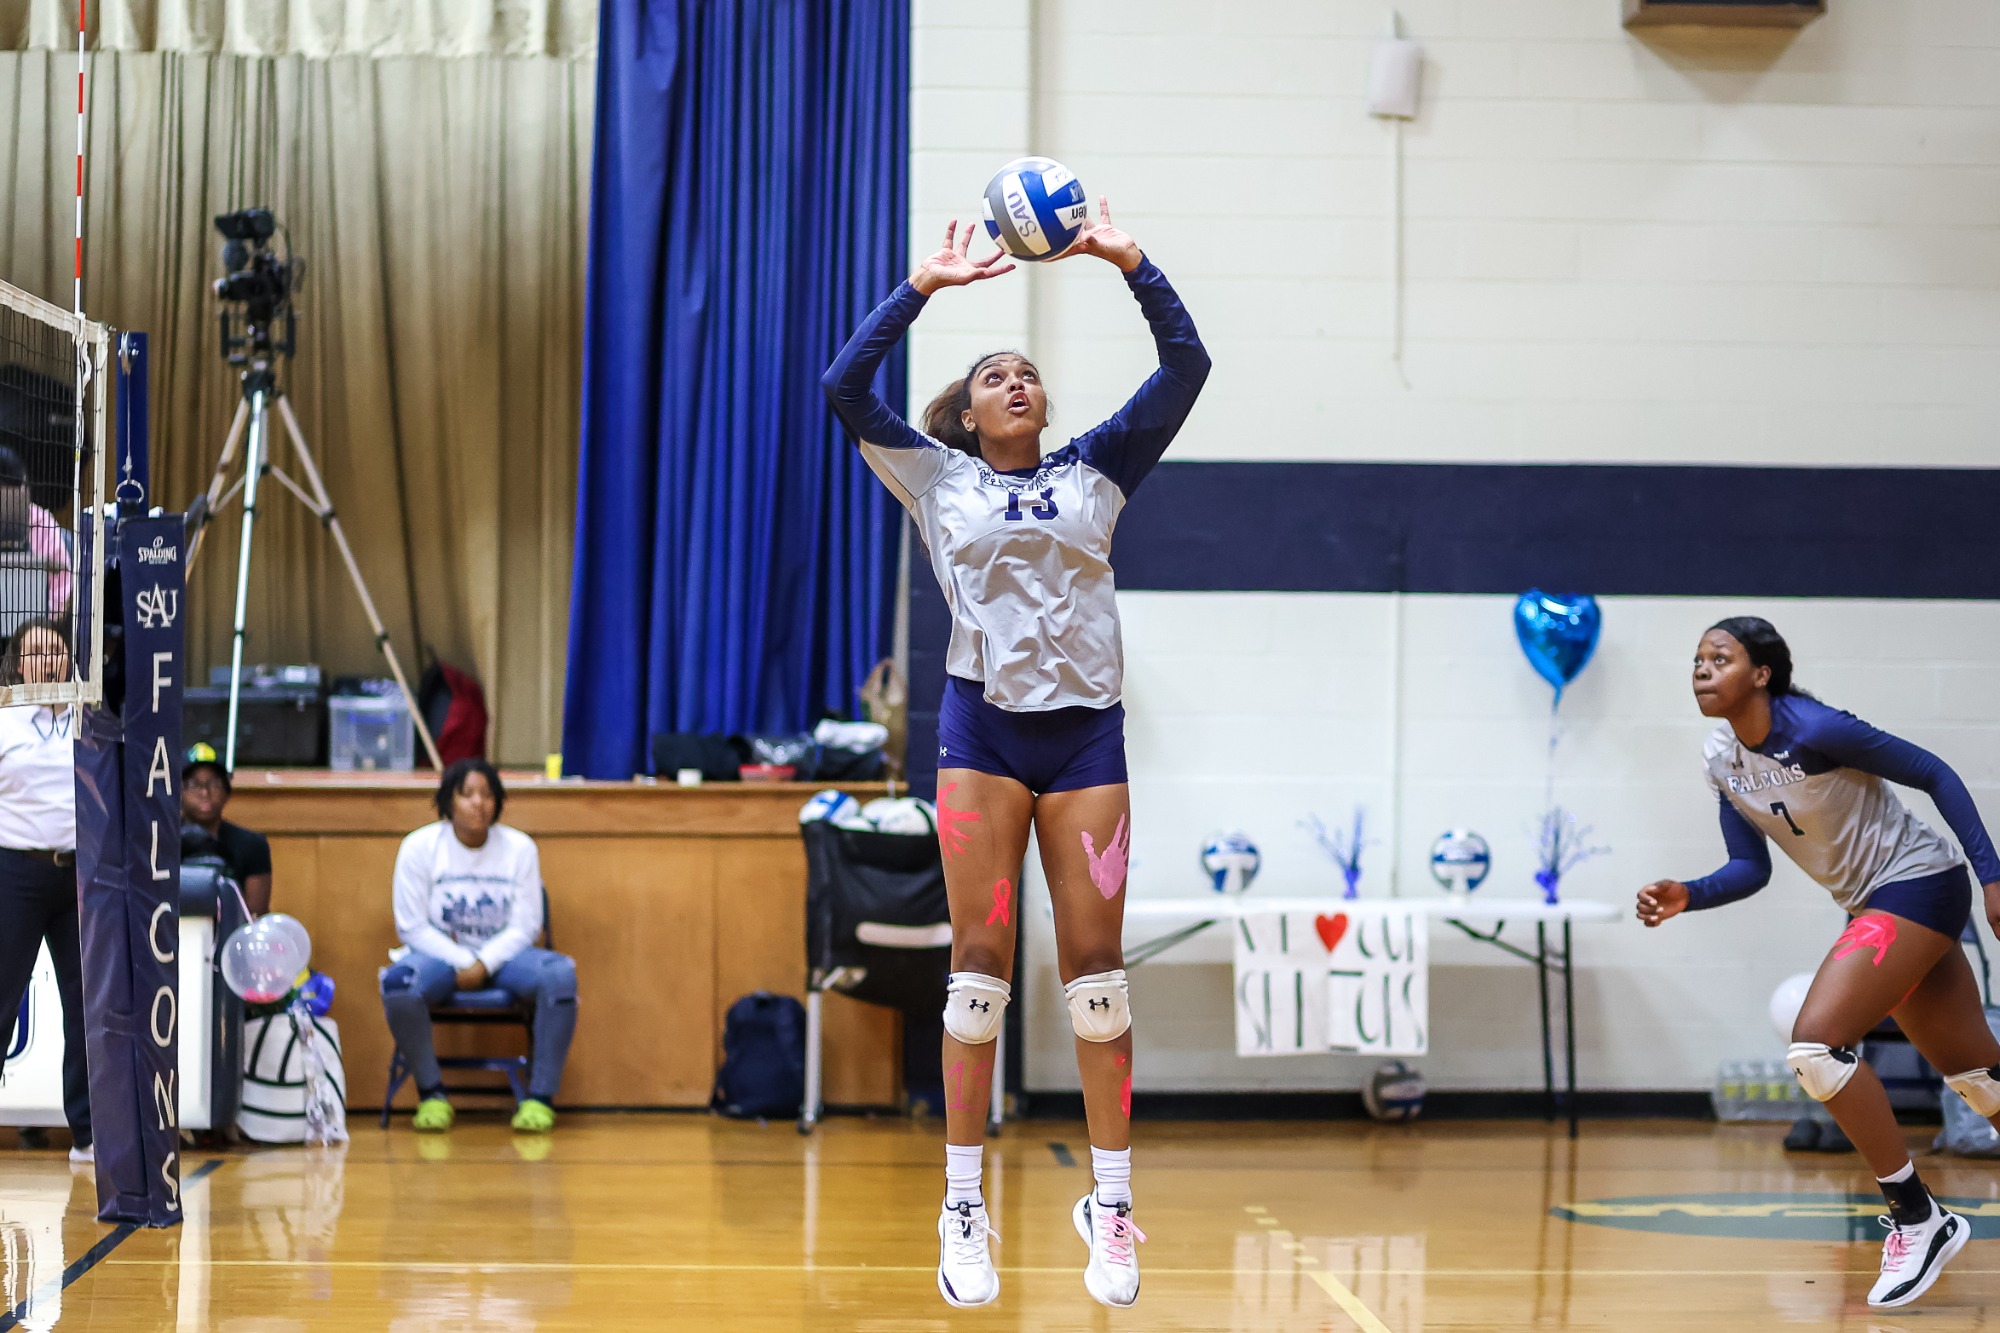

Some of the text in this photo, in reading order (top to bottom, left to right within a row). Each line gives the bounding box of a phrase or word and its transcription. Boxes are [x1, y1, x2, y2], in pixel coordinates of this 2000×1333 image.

[1008, 191, 1037, 238] SAU
[1004, 487, 1059, 521] 13
[138, 546, 177, 563] SPALDING
[136, 582, 178, 629] SAU
[1727, 762, 1807, 794] FALCONS
[1769, 801, 1806, 836] 7
[146, 651, 179, 1212] FALCONS
